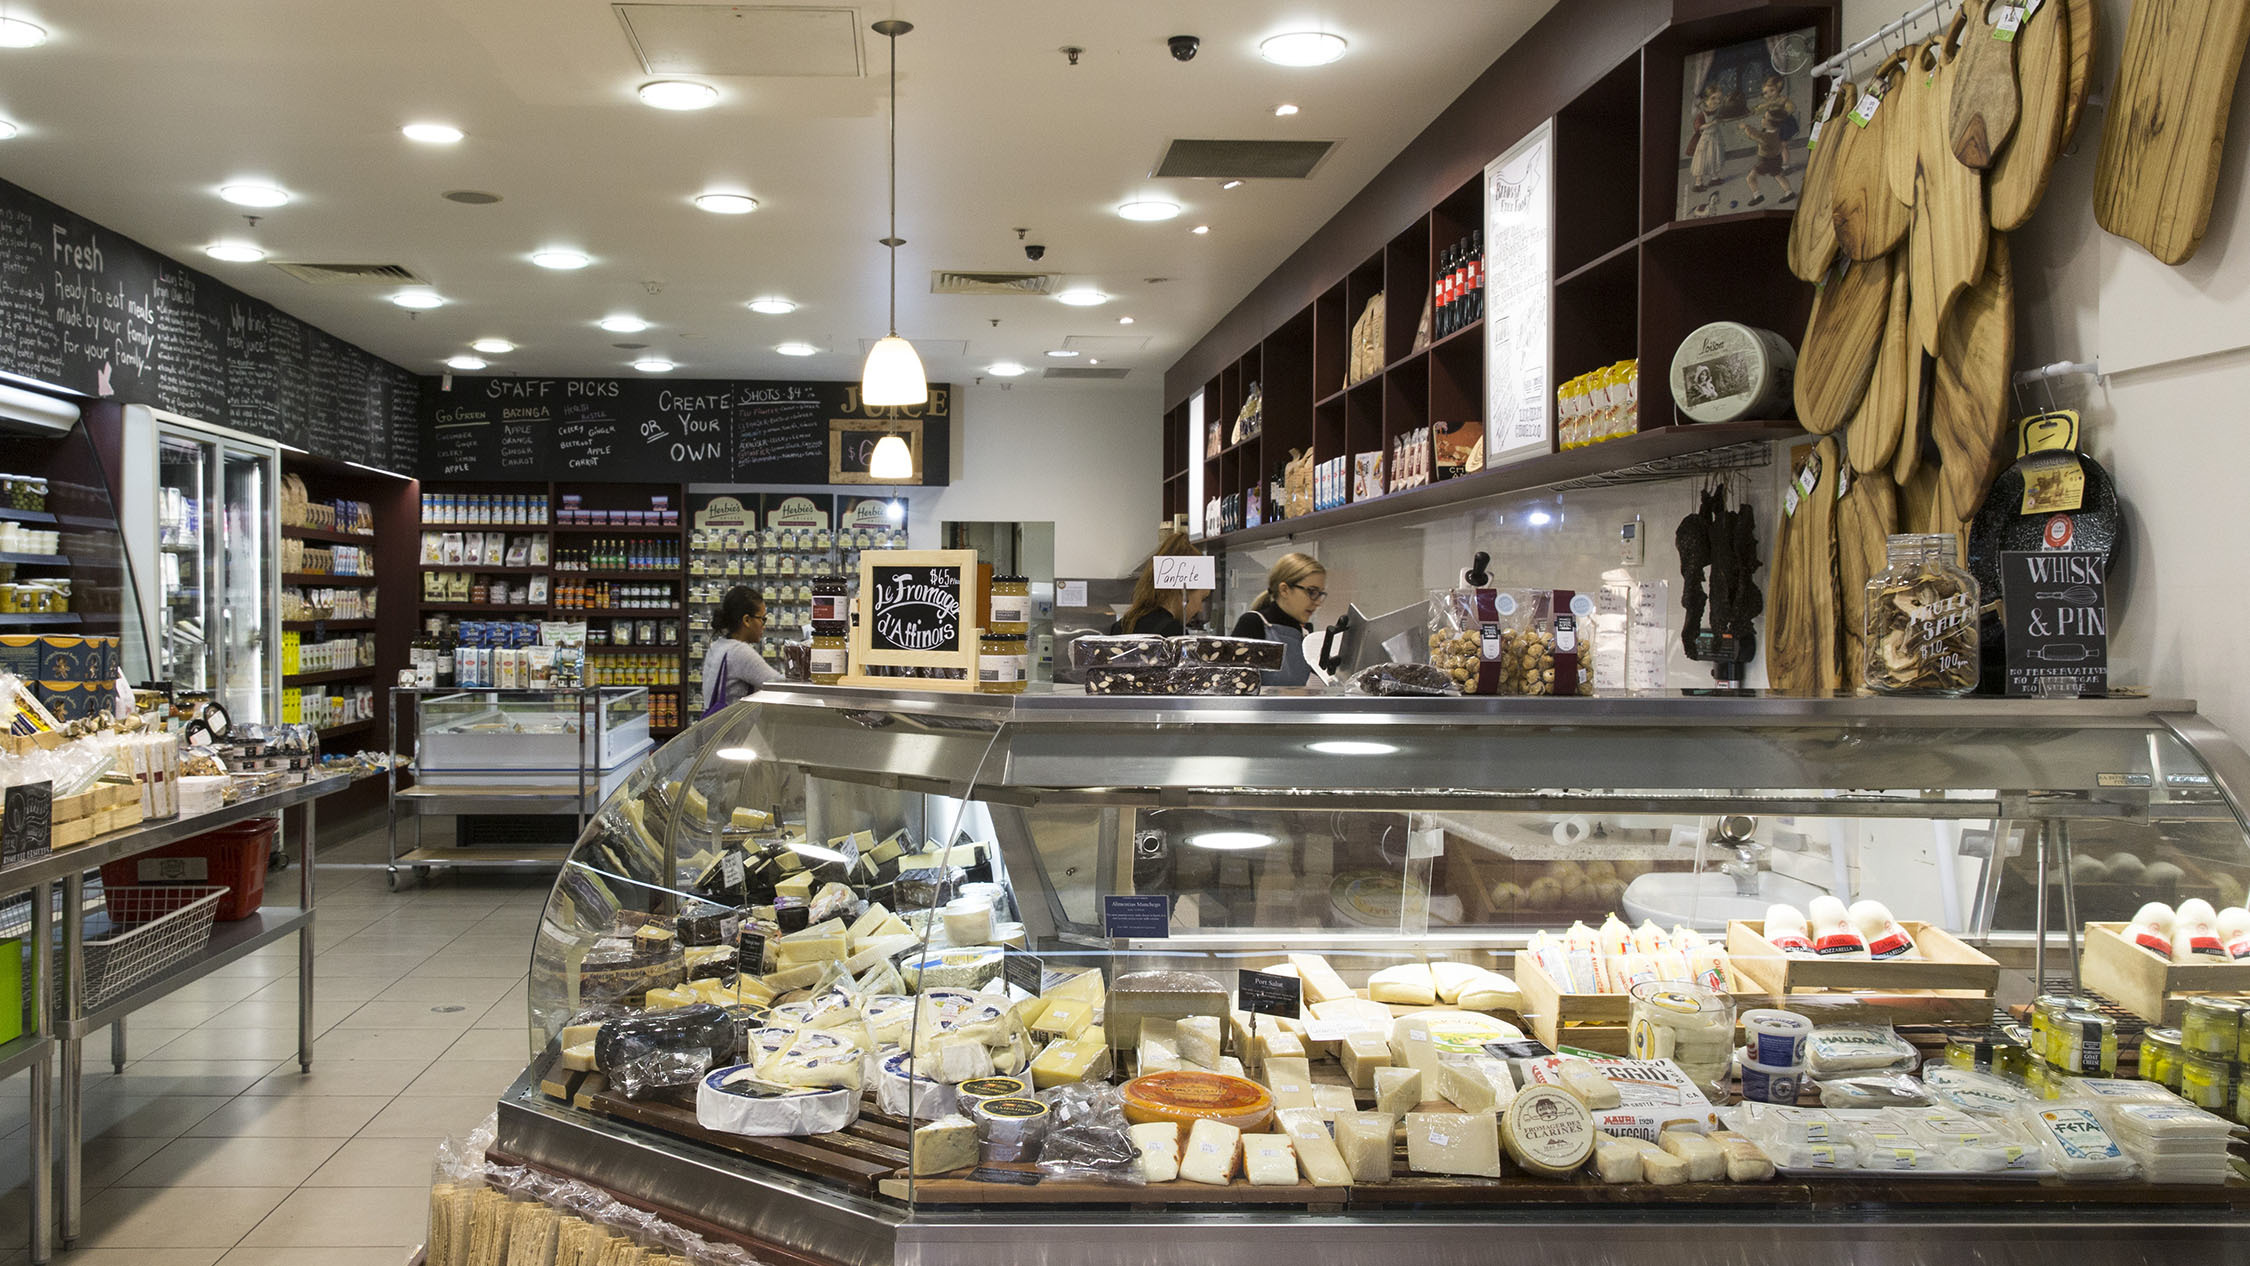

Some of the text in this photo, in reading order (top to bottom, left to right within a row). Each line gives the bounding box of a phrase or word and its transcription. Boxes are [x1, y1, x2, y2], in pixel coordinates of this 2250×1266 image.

[53, 224, 104, 273] Fresh
[55, 270, 88, 314] Ready
[91, 278, 103, 304] to
[106, 281, 125, 311] eat
[128, 293, 155, 325] meals
[57, 304, 83, 328] made
[85, 306, 100, 341] by
[103, 317, 121, 334] our
[127, 319, 155, 359] family
[63, 330, 80, 354] for
[84, 344, 110, 363] your
[487, 379, 620, 398] STAFF PICKS
[740, 387, 781, 404] SHOTS
[658, 390, 731, 411] CREATE
[503, 406, 550, 419] BAZINGA
[504, 425, 533, 435] APPLE
[640, 419, 662, 436] OR
[678, 413, 721, 436] YOUR
[586, 445, 612, 455] APPLE
[670, 442, 721, 462] OWN
[444, 463, 470, 474] APPLE
[568, 456, 600, 468] CARROT
[709, 501, 741, 515] Herbie's
[782, 501, 814, 516] Herbie's
[930, 568, 950, 586] $65
[1156, 557, 1200, 587] Panforte
[2025, 556, 2102, 585] WHISK
[877, 611, 956, 648] d'Affinois
[2028, 606, 2106, 637] & PIN
[1523, 1122, 1567, 1134] FROMAGER
[1603, 1115, 1636, 1126] MAURI
[2054, 1122, 2101, 1133] FETA
[1525, 1124, 1584, 1141] CLARINES
